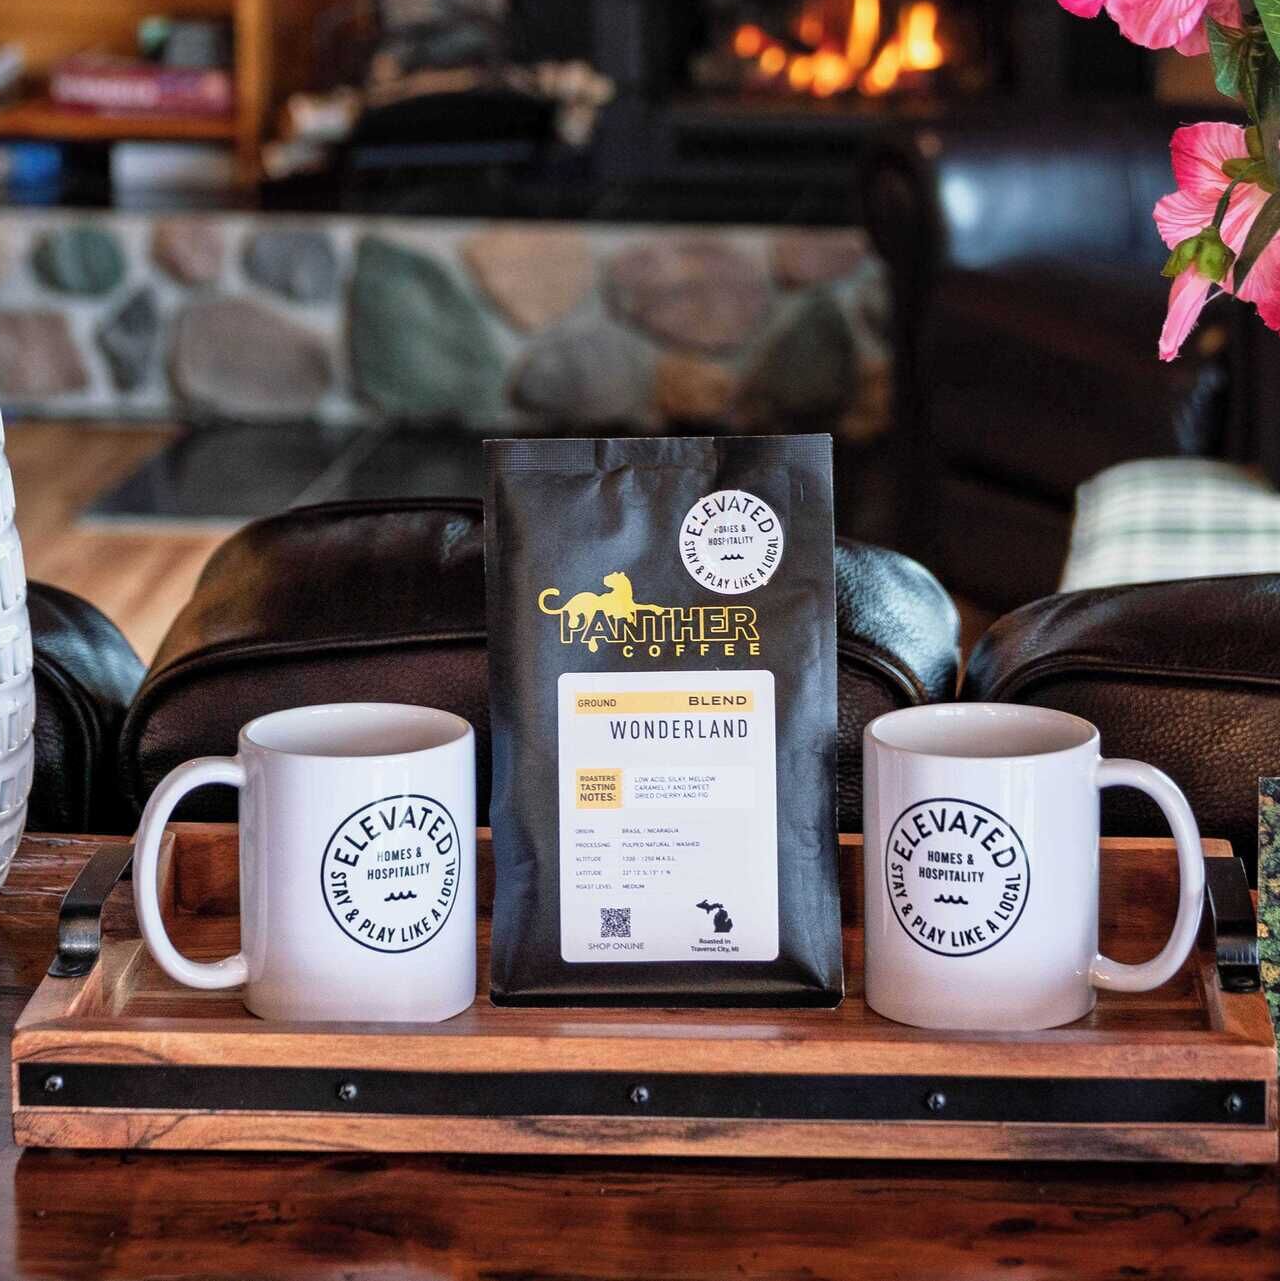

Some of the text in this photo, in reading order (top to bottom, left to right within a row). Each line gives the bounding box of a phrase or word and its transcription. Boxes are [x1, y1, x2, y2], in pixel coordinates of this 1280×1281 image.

[687, 496, 774, 536] ELEVATED
[685, 536, 778, 589] STAY & PLAY LIKE A LOCAL
[560, 606, 759, 643] PANTHER
[623, 643, 760, 658] COFFEE
[578, 696, 747, 707] GROUND BLEND
[610, 720, 748, 739] WONDERLAND
[580, 793, 616, 802] NOTES:
[334, 806, 452, 867] ELEVATED
[894, 808, 1016, 868] ELEVATED
[377, 847, 422, 862] HOMES &
[928, 850, 974, 864] HOMES &
[367, 863, 430, 880] HOSPITALITY
[919, 867, 984, 882] HOSPITALITY
[331, 858, 455, 943] STAY & PLAY LIKE A LOCAL
[891, 863, 1020, 947] STAY & PLAY LIKE A LOCAL
[588, 942, 644, 951] SHOP ONLINE
